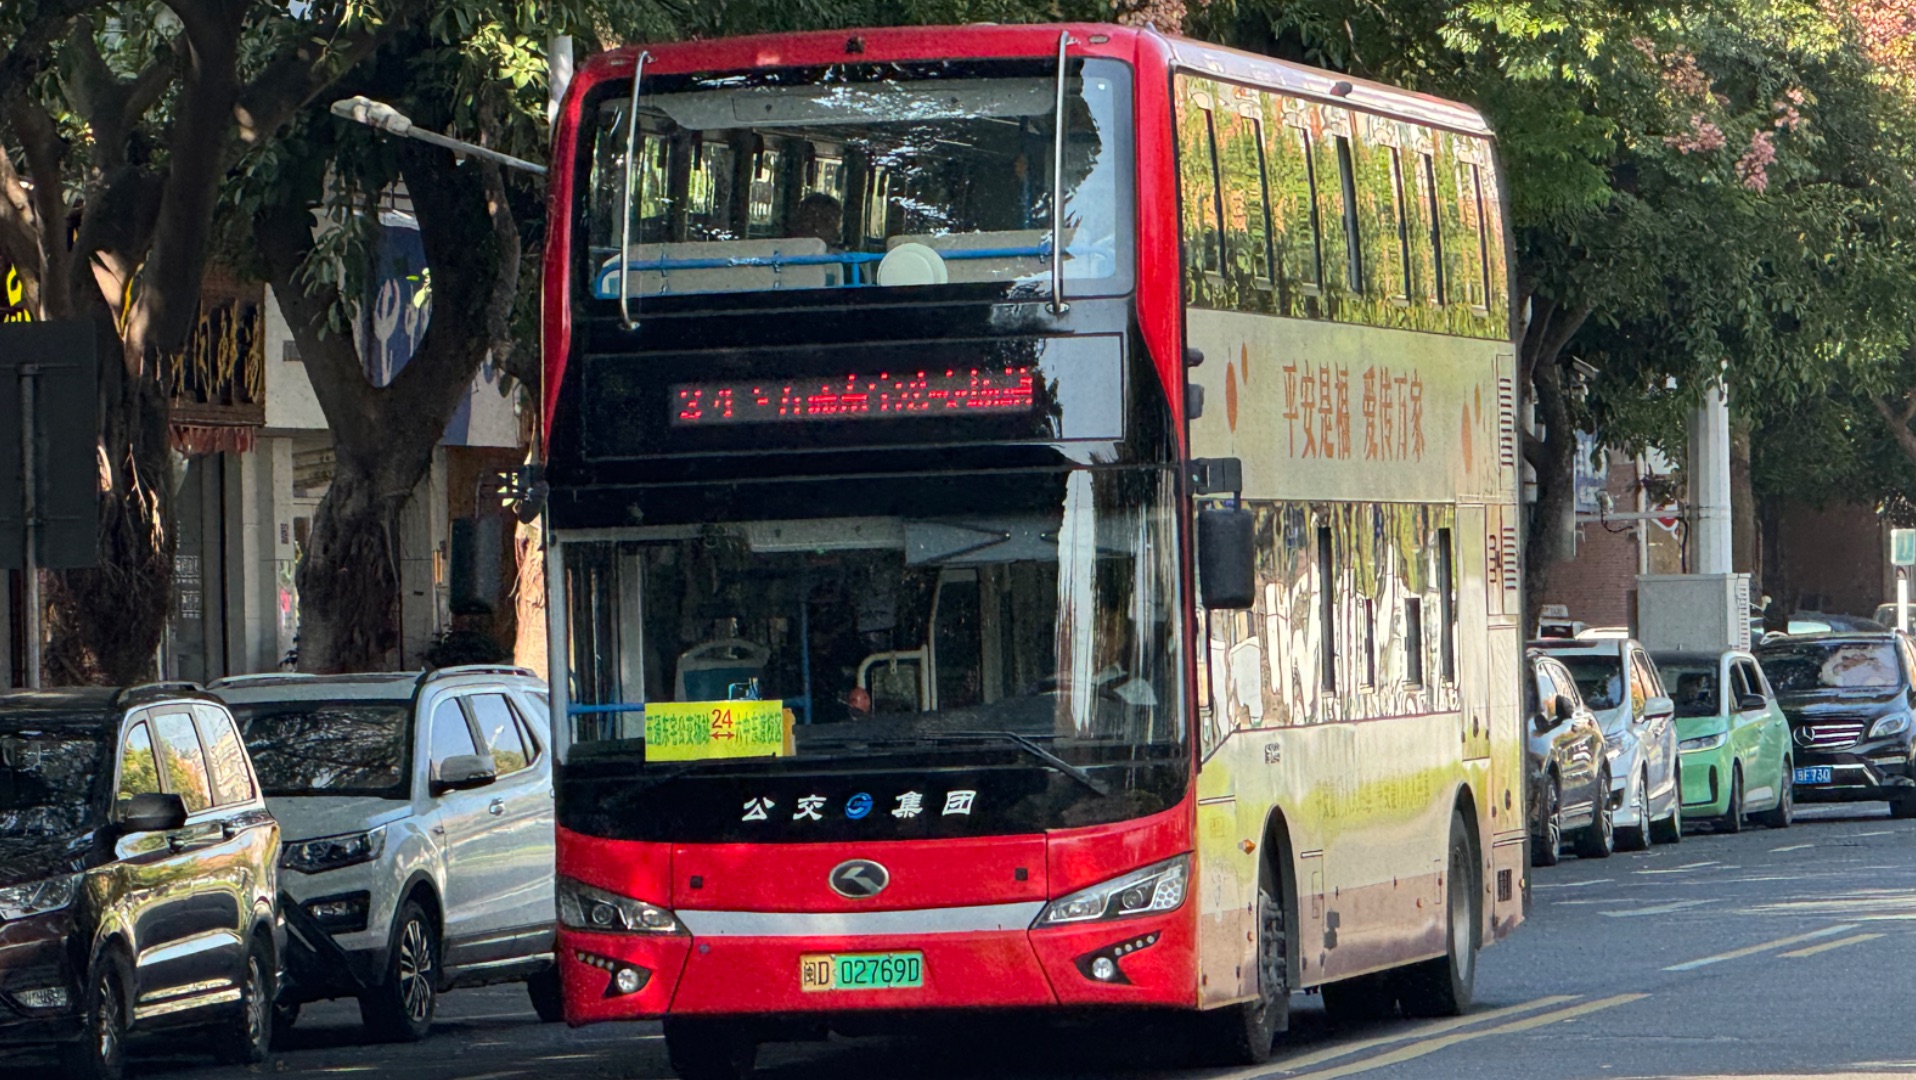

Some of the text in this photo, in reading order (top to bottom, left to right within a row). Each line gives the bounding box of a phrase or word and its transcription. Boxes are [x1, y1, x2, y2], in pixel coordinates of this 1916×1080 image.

[1282, 358, 1351, 460] 平安是福
[711, 709, 733, 728] 24
